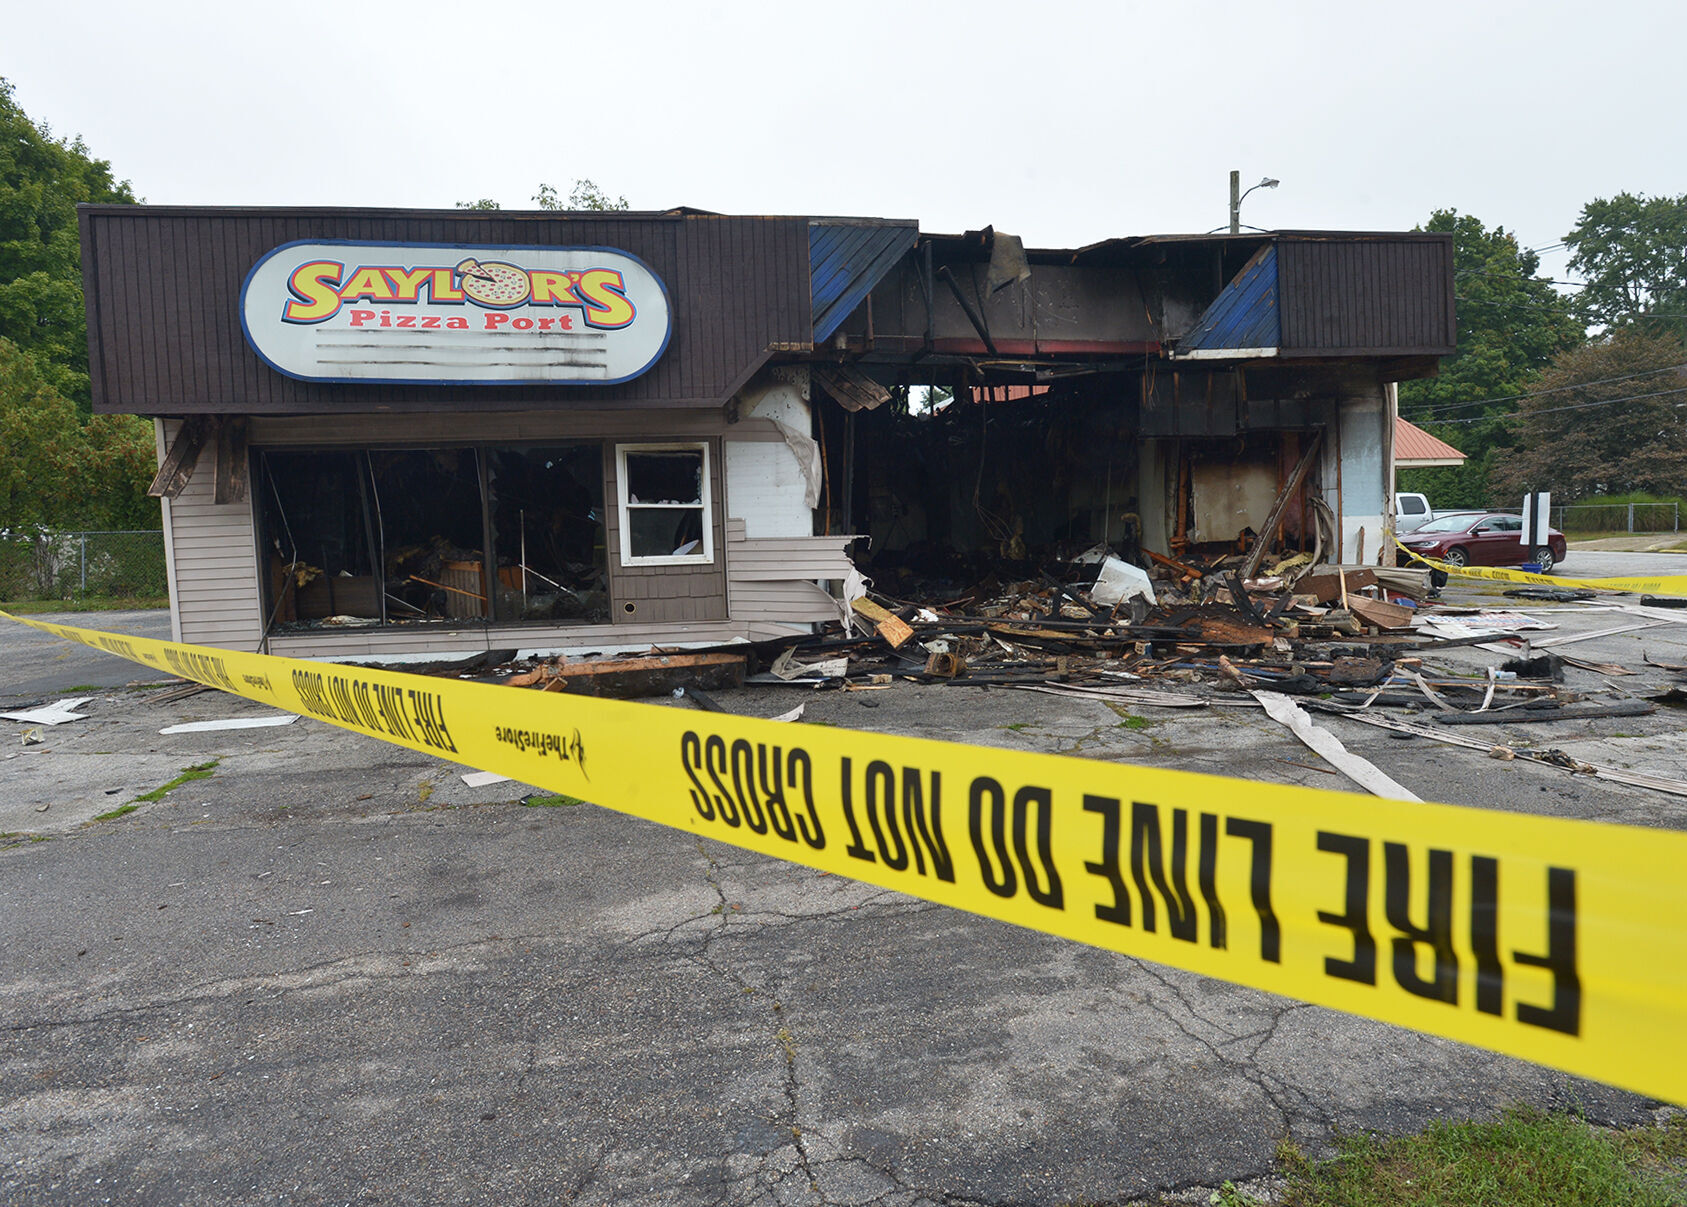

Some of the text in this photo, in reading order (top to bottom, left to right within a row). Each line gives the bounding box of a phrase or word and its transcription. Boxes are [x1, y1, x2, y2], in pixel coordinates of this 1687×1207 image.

[281, 258, 637, 329] SAYLOR'S
[349, 309, 574, 331] Pizza Port
[292, 669, 339, 721] CROSS
[327, 675, 365, 728] NOT
[353, 679, 385, 732] DO
[373, 683, 420, 743] LINE
[408, 689, 459, 754] FIRE
[496, 726, 569, 761] TheFireStore
[681, 730, 1583, 1040] FIRE LINE DO NOT CROSS
